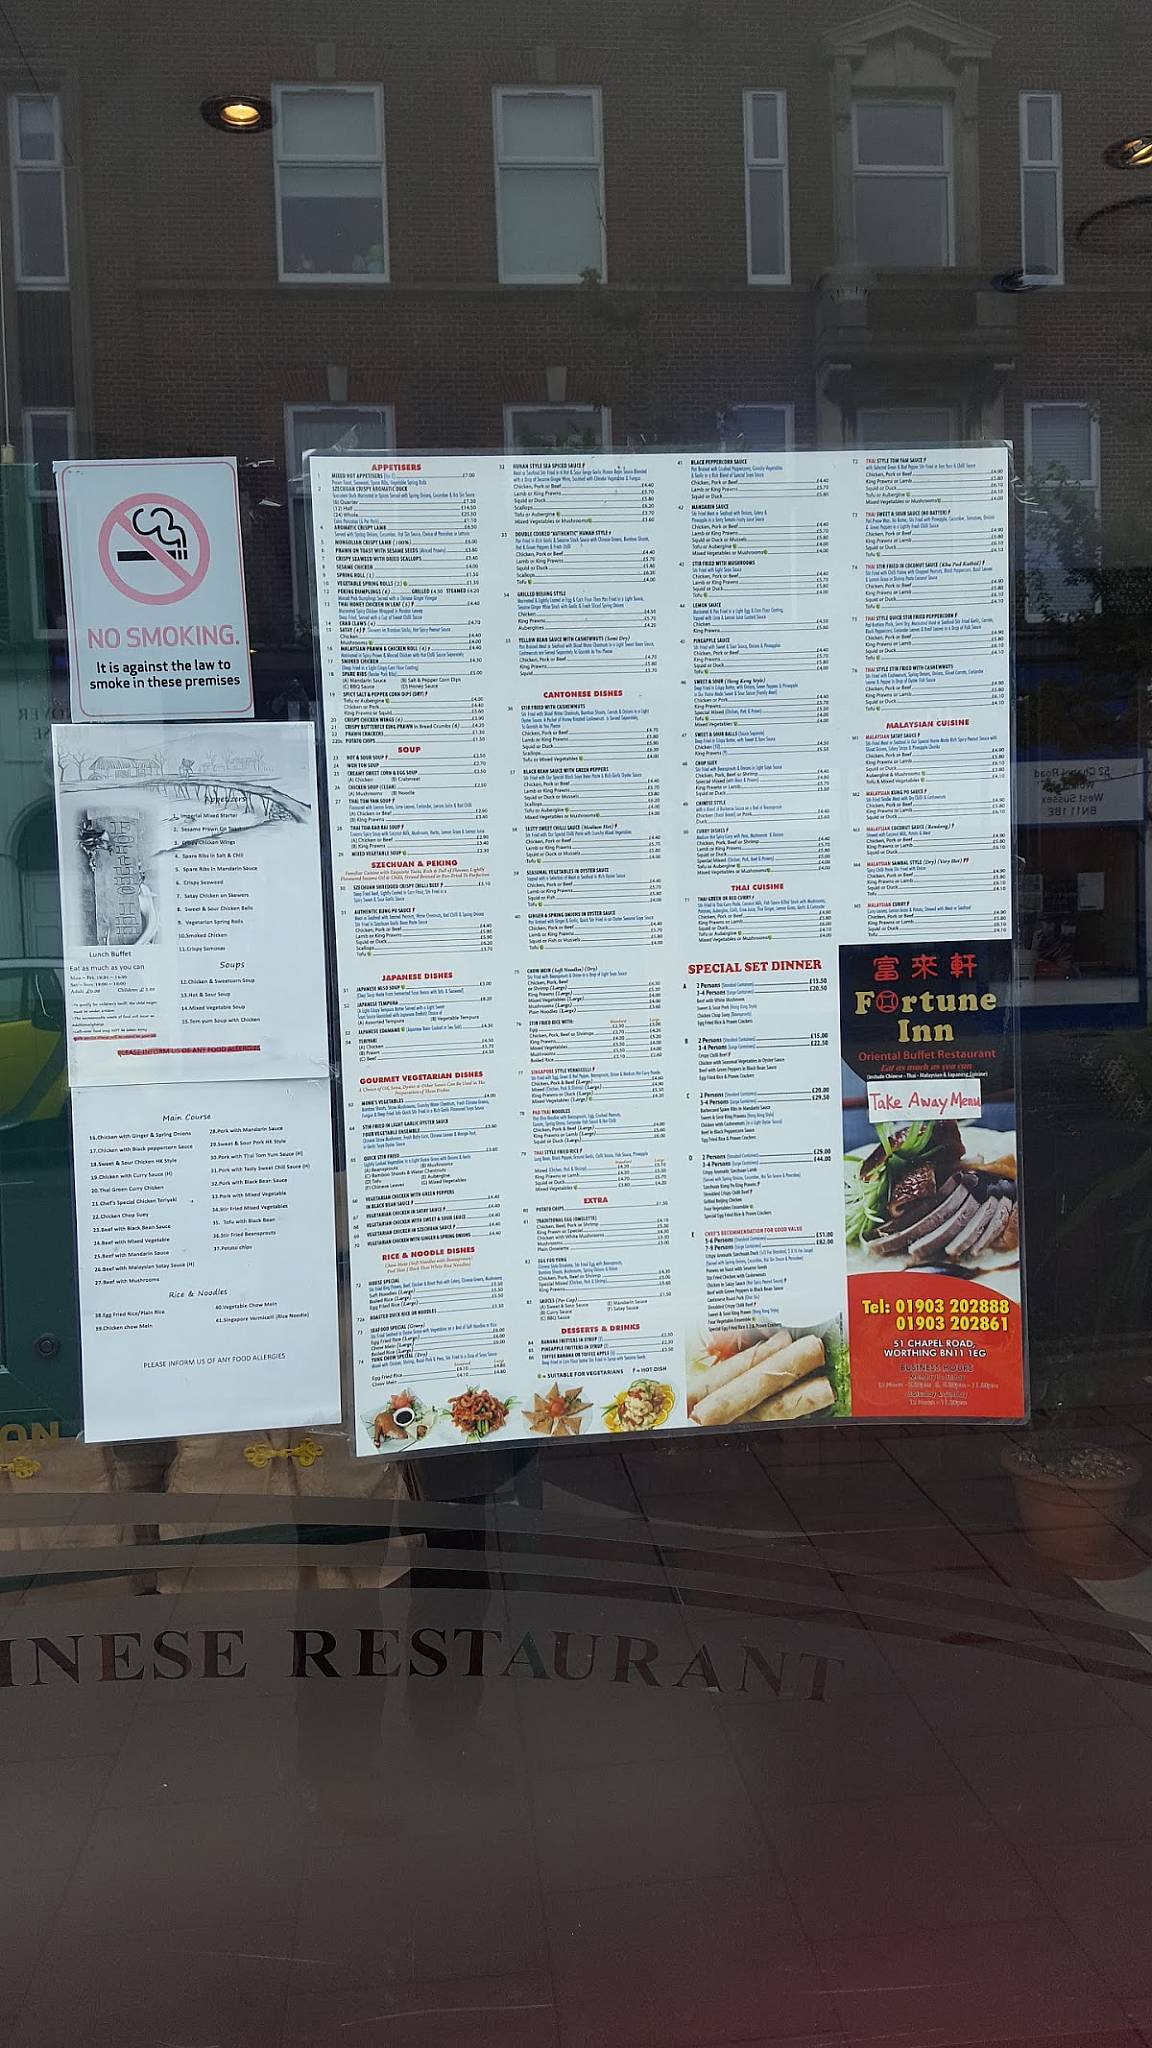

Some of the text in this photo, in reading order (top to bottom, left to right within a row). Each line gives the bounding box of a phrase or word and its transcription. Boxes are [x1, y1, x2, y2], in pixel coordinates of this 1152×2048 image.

[88, 625, 240, 649] NO SMOKING.
[96, 659, 231, 676] It is against the law to
[90, 675, 240, 690] smoke in these premises
[886, 719, 969, 729] MALAYSIAN CUISINE
[204, 795, 247, 804] Appetizers
[220, 961, 245, 970] Soups
[688, 960, 822, 974] SPECIAL SET DINNER
[873, 952, 977, 982] 富來軒
[382, 973, 421, 981] JAPANESE
[898, 1019, 954, 1043] Inn
[859, 1049, 996, 1062] Oriental Buffet Restaurant
[360, 1076, 400, 1084] GOURMET
[402, 1072, 452, 1081] VEGETARIAN
[869, 1092, 981, 1114] Take Away Menu
[163, 1114, 182, 1122] Main
[411, 1250, 444, 1258] NOODLE
[198, 1288, 227, 1297] Noodles
[862, 1299, 1009, 1314] Tel: 01903 202888
[896, 1316, 1008, 1331] 01903 202861
[946, 1340, 976, 1348] ROAD,
[968, 1349, 986, 1357] 1EG
[169, 1359, 195, 1367] INFORM
[217, 1356, 231, 1364] ANY
[253, 1353, 286, 1361] ALLERGIES
[286, 1628, 846, 1703] RESTAURANT
